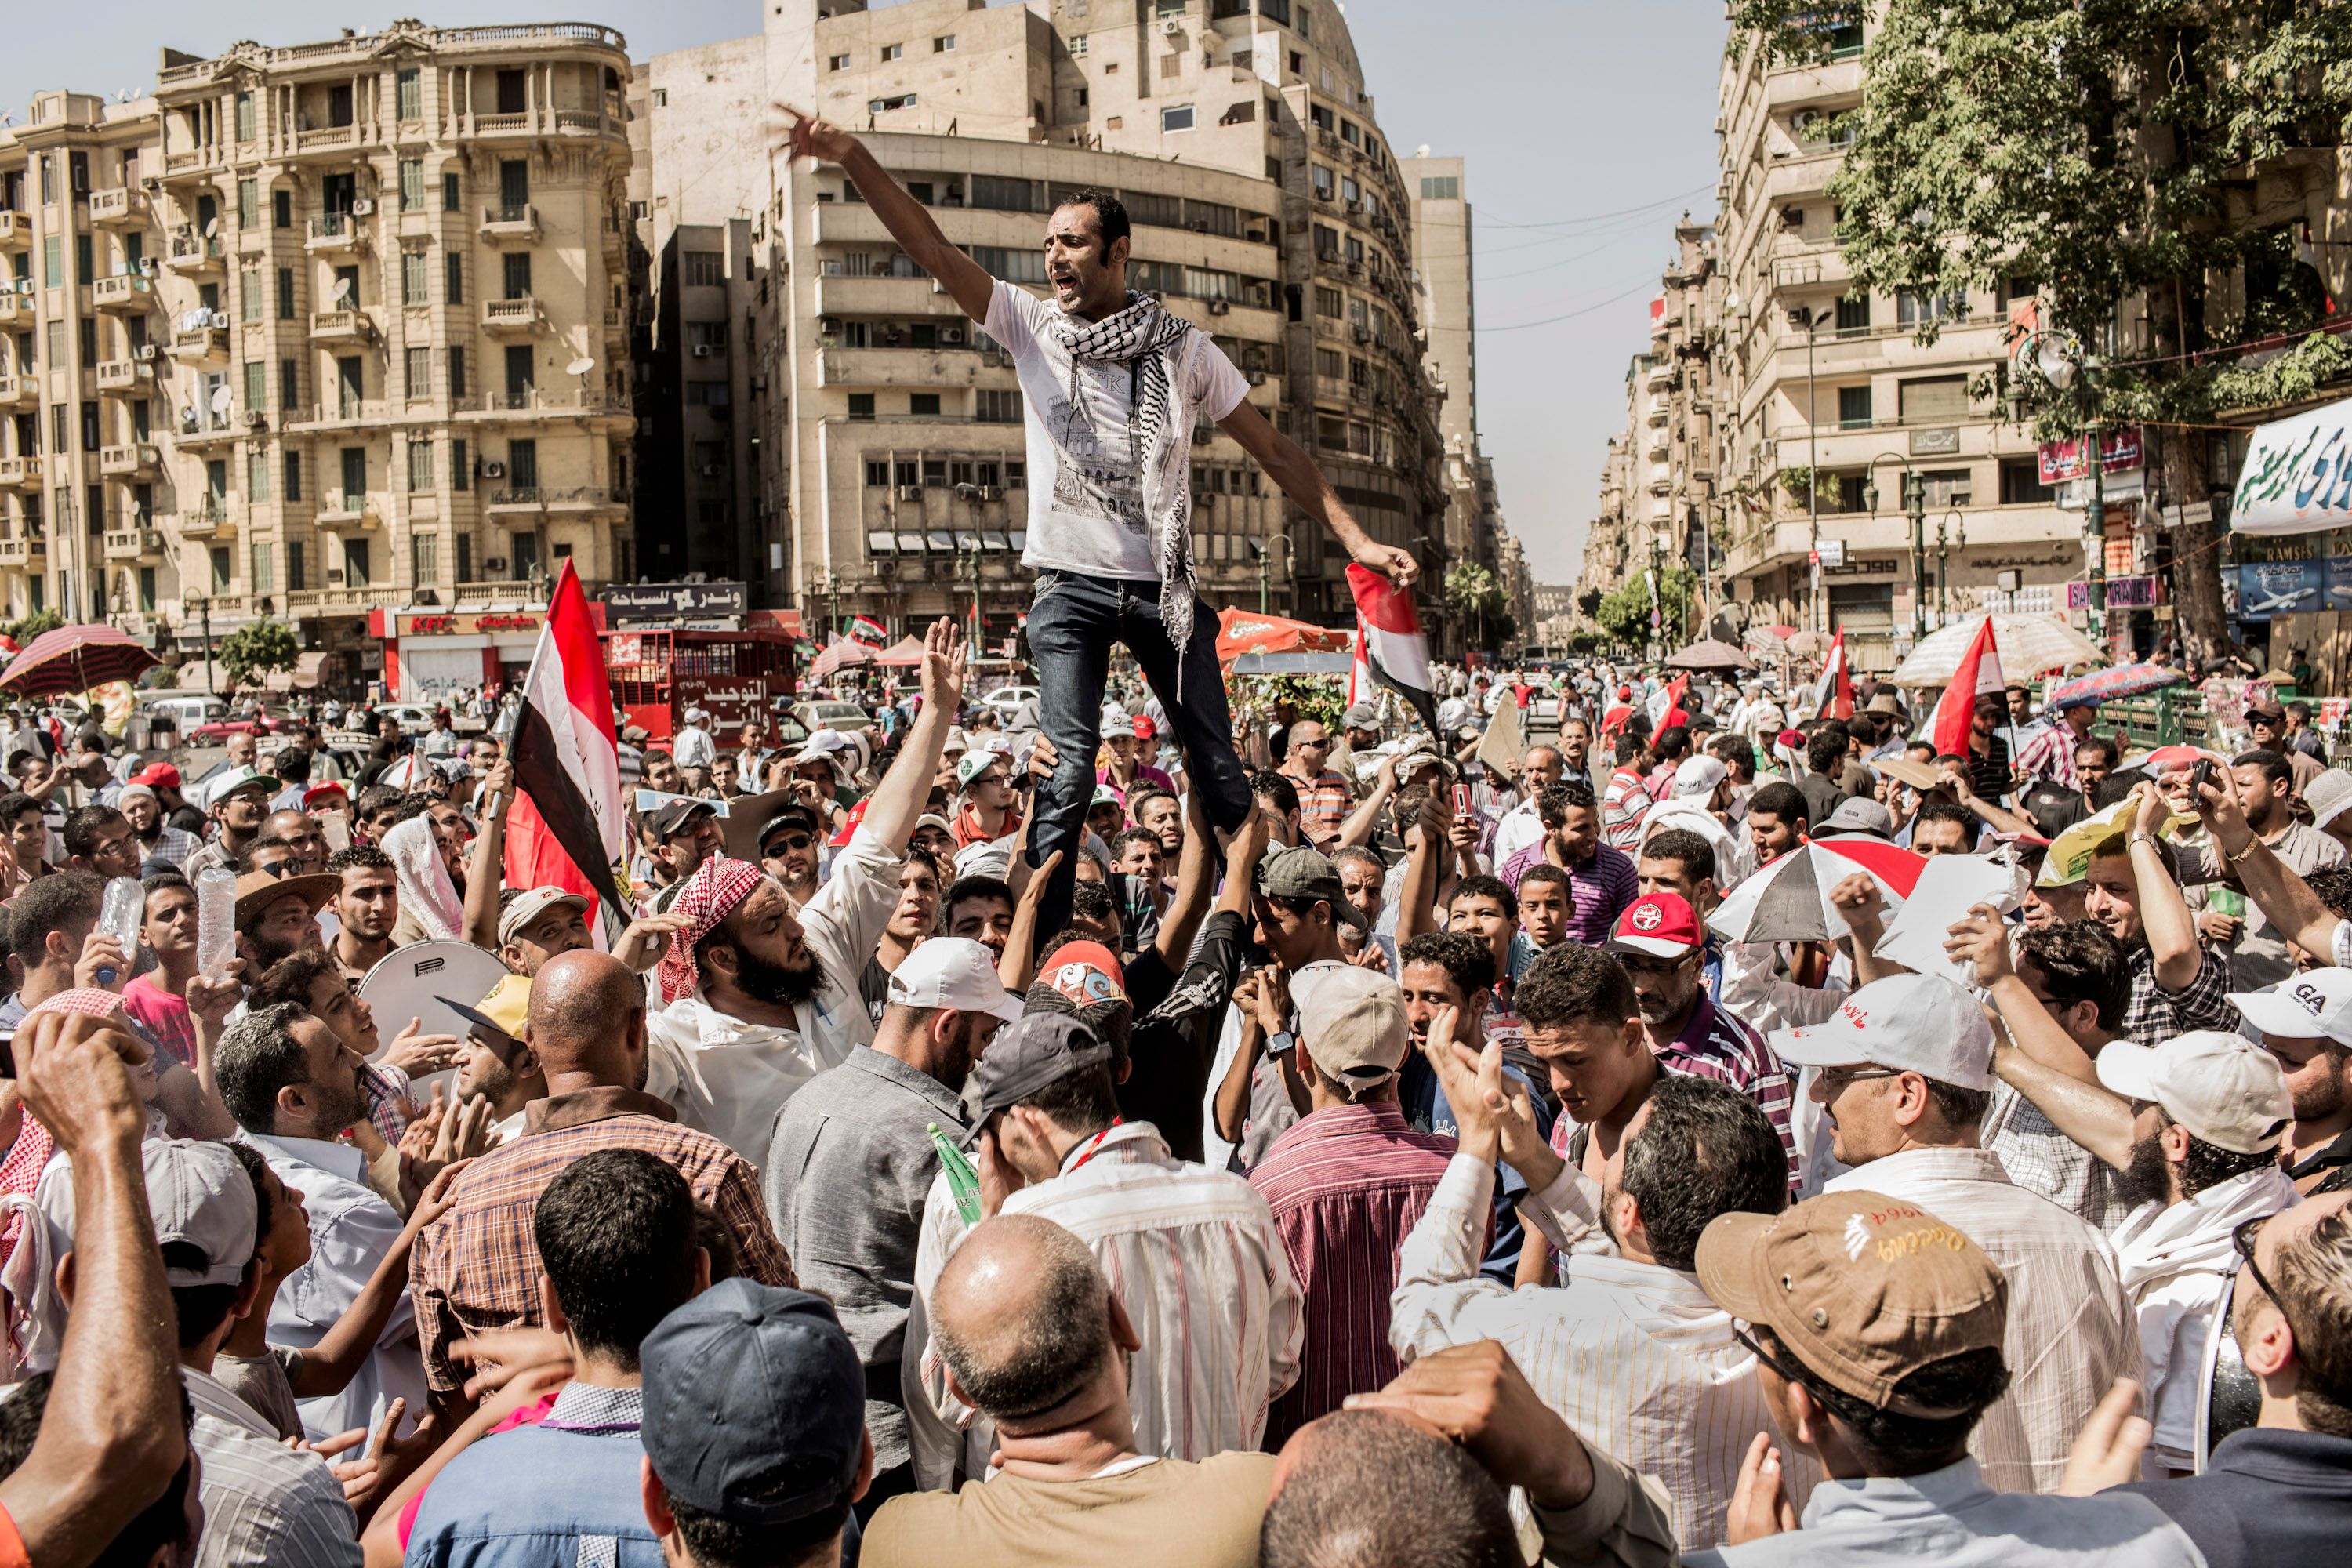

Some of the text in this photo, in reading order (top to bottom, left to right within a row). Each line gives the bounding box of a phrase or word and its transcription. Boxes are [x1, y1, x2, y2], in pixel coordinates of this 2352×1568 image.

[2267, 546, 2312, 561] RAMSES
[611, 589, 742, 610] وندر للسياحة
[2107, 580, 2152, 604] TRAVEL
[410, 615, 452, 632] KFC
[705, 680, 767, 706] التوحيد
[2296, 984, 2325, 1013] GA
[1878, 1223, 1966, 1263] Racing
